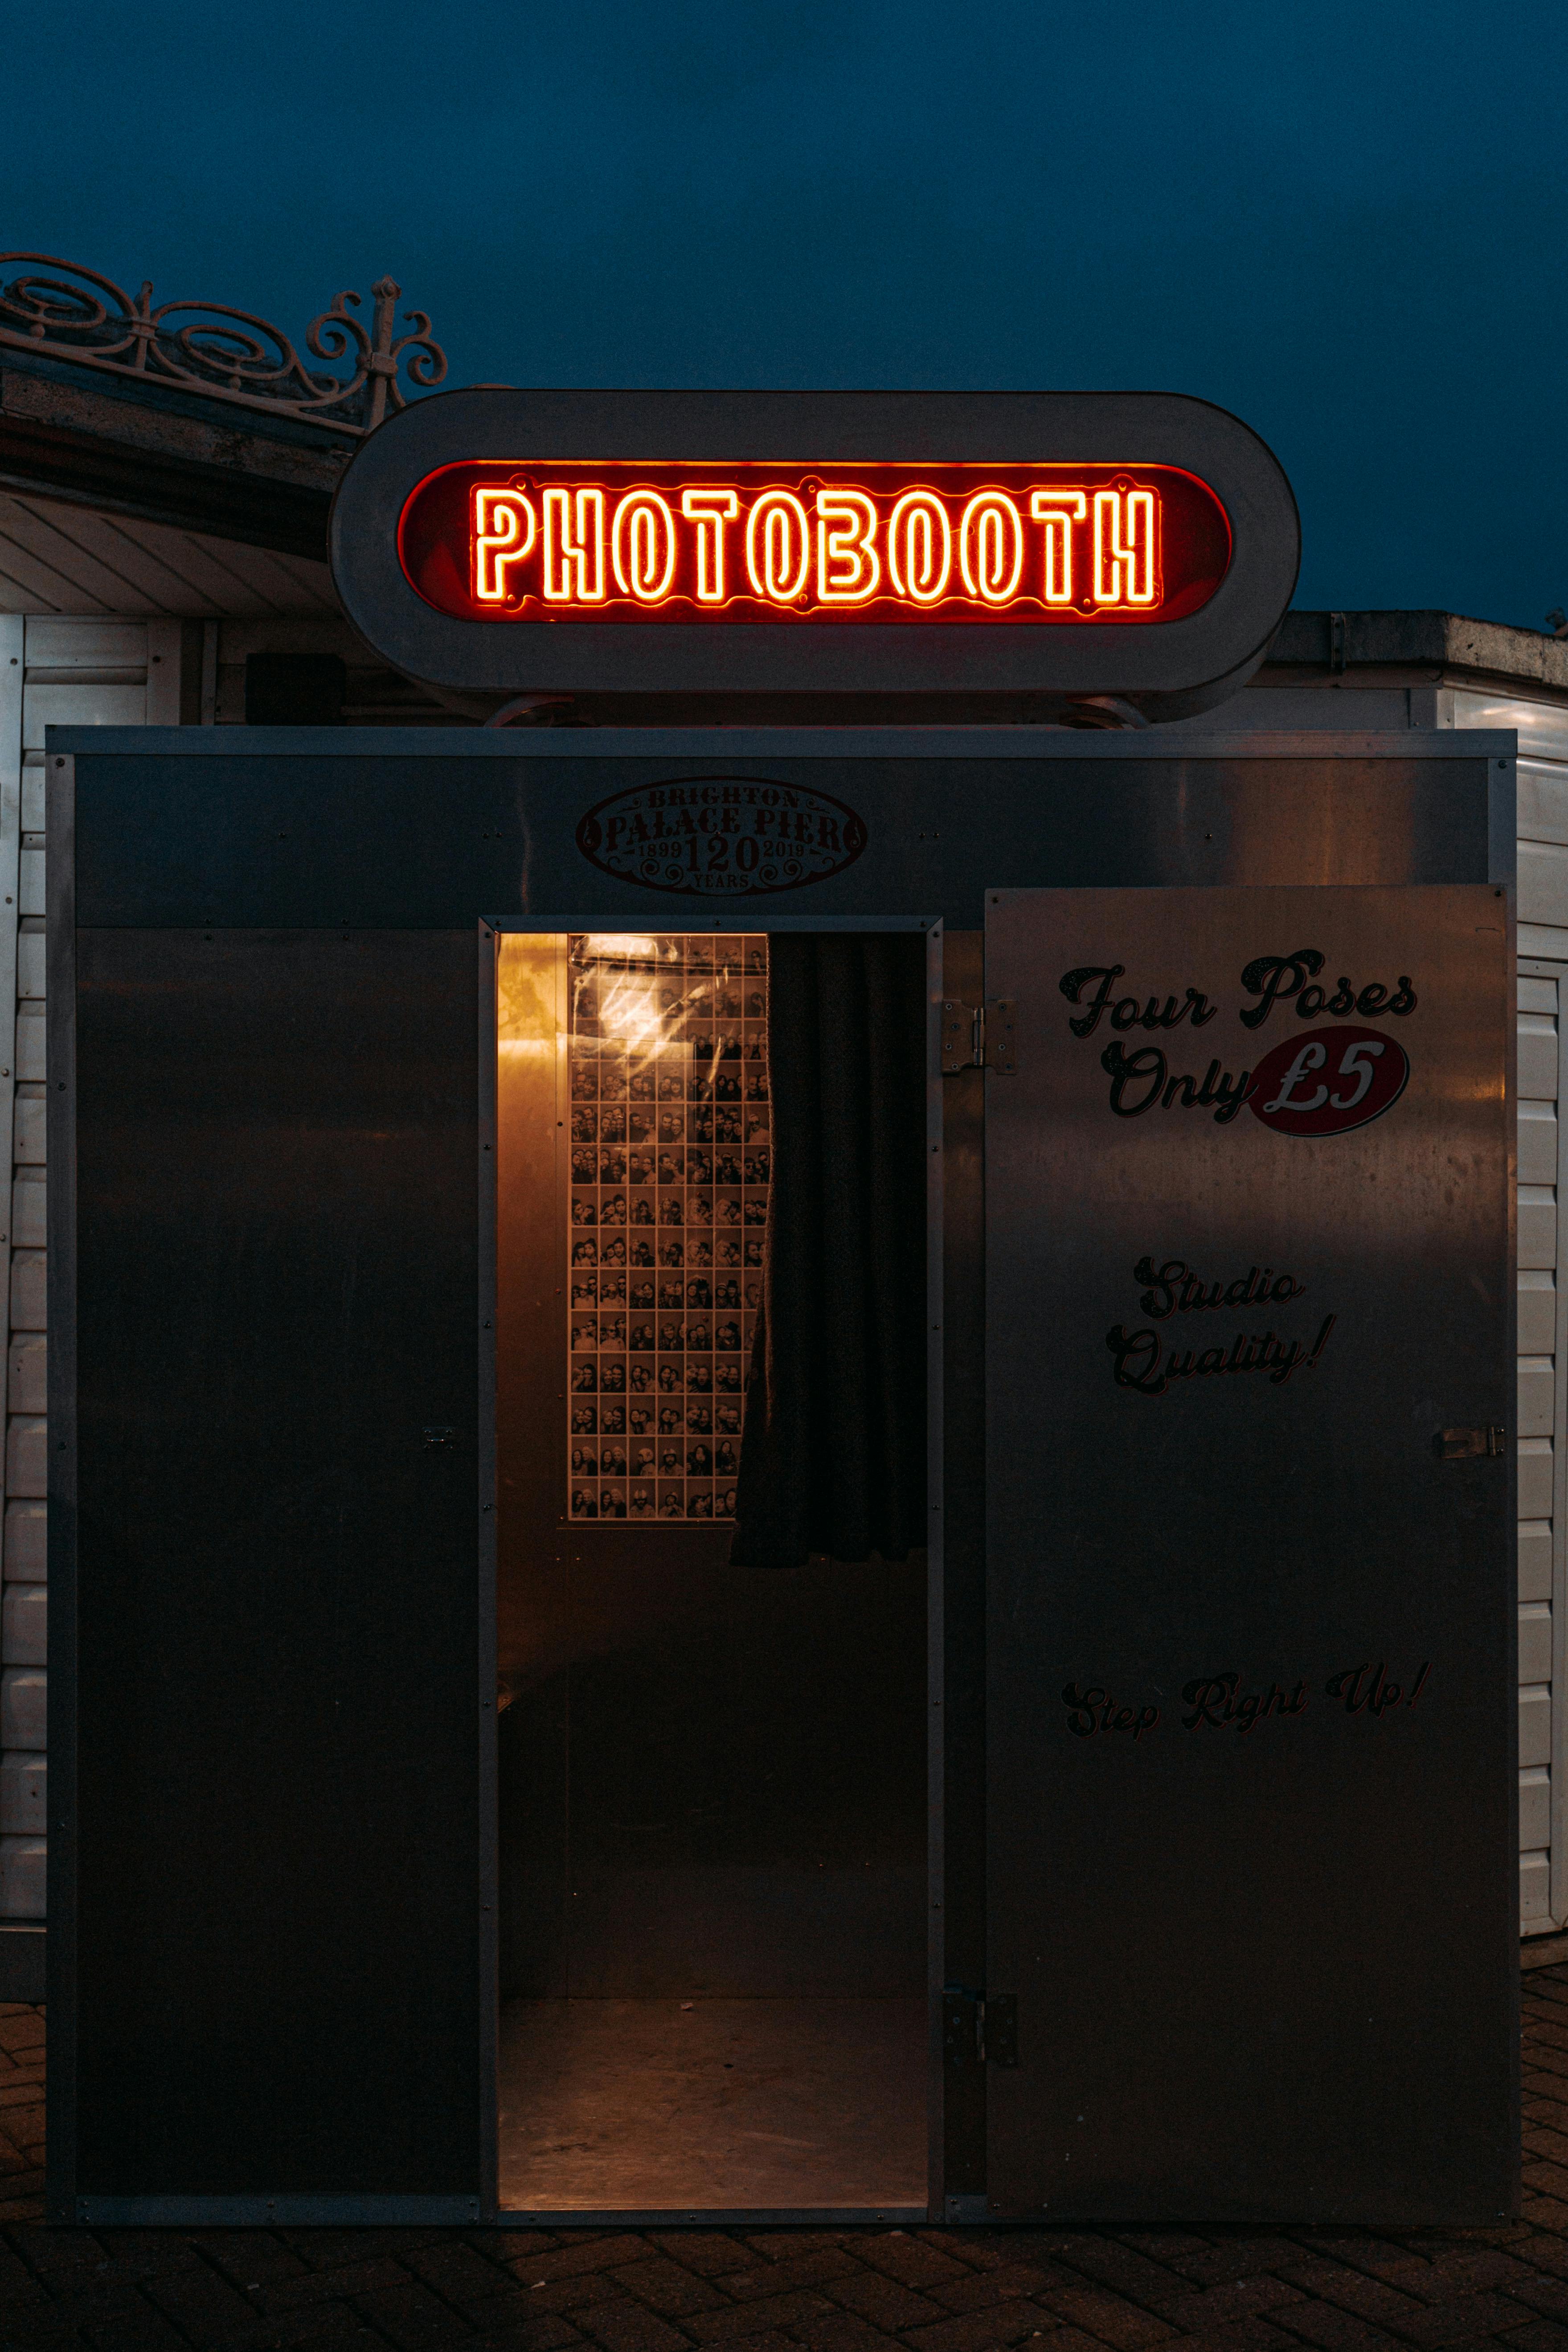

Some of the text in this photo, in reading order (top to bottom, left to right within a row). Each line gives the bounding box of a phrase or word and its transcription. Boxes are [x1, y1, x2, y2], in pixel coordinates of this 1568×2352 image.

[474, 489, 1155, 604] PHOTOBOOTH
[606, 808, 841, 853] PALACE PIER
[647, 787, 800, 808] BRIGHTON
[639, 836, 804, 872] 1899 120 2019
[694, 874, 749, 888] YEARS
[1059, 949, 1417, 1038] Four Poses
[1101, 1041, 1385, 1124] Only £5
[1134, 1256, 1306, 1320] Studio
[1105, 1314, 1336, 1397] Quality!
[1061, 1662, 1432, 1741] Step Right Up!
